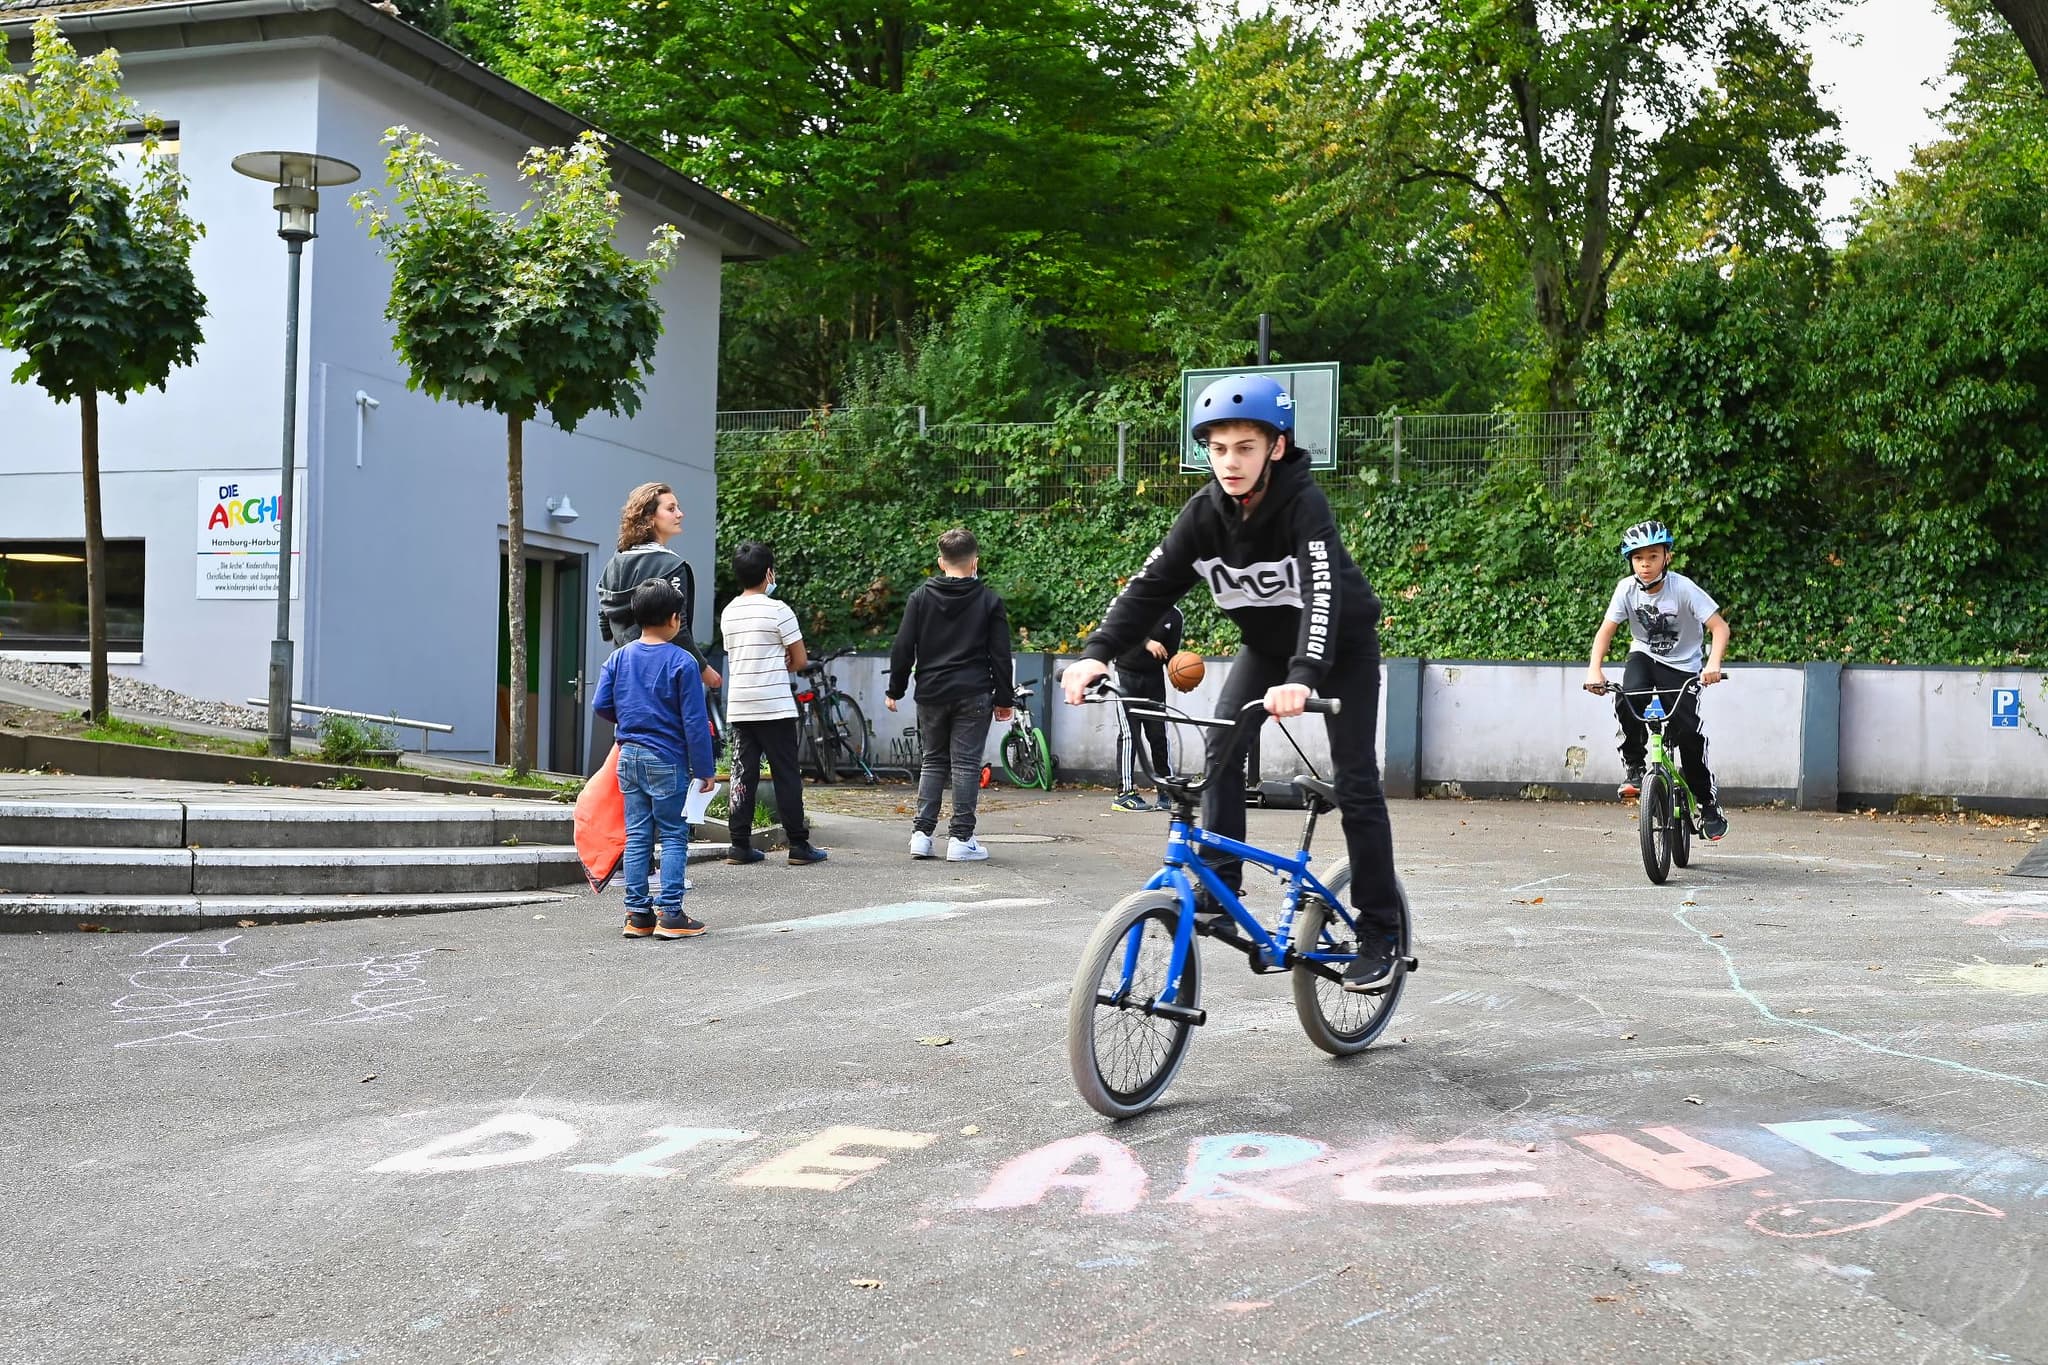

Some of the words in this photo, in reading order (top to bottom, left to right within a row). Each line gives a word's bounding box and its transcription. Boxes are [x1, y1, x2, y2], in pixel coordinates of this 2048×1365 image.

[219, 484, 239, 499] DIE
[212, 539, 280, 547] Hamburg-Harbur
[246, 562, 278, 571] Kinderstiftung
[1307, 540, 1332, 592] SPACE
[206, 572, 231, 580] Christliches
[250, 572, 259, 580] und
[1998, 691, 2014, 714] P
[363, 1112, 942, 1192] DIE
